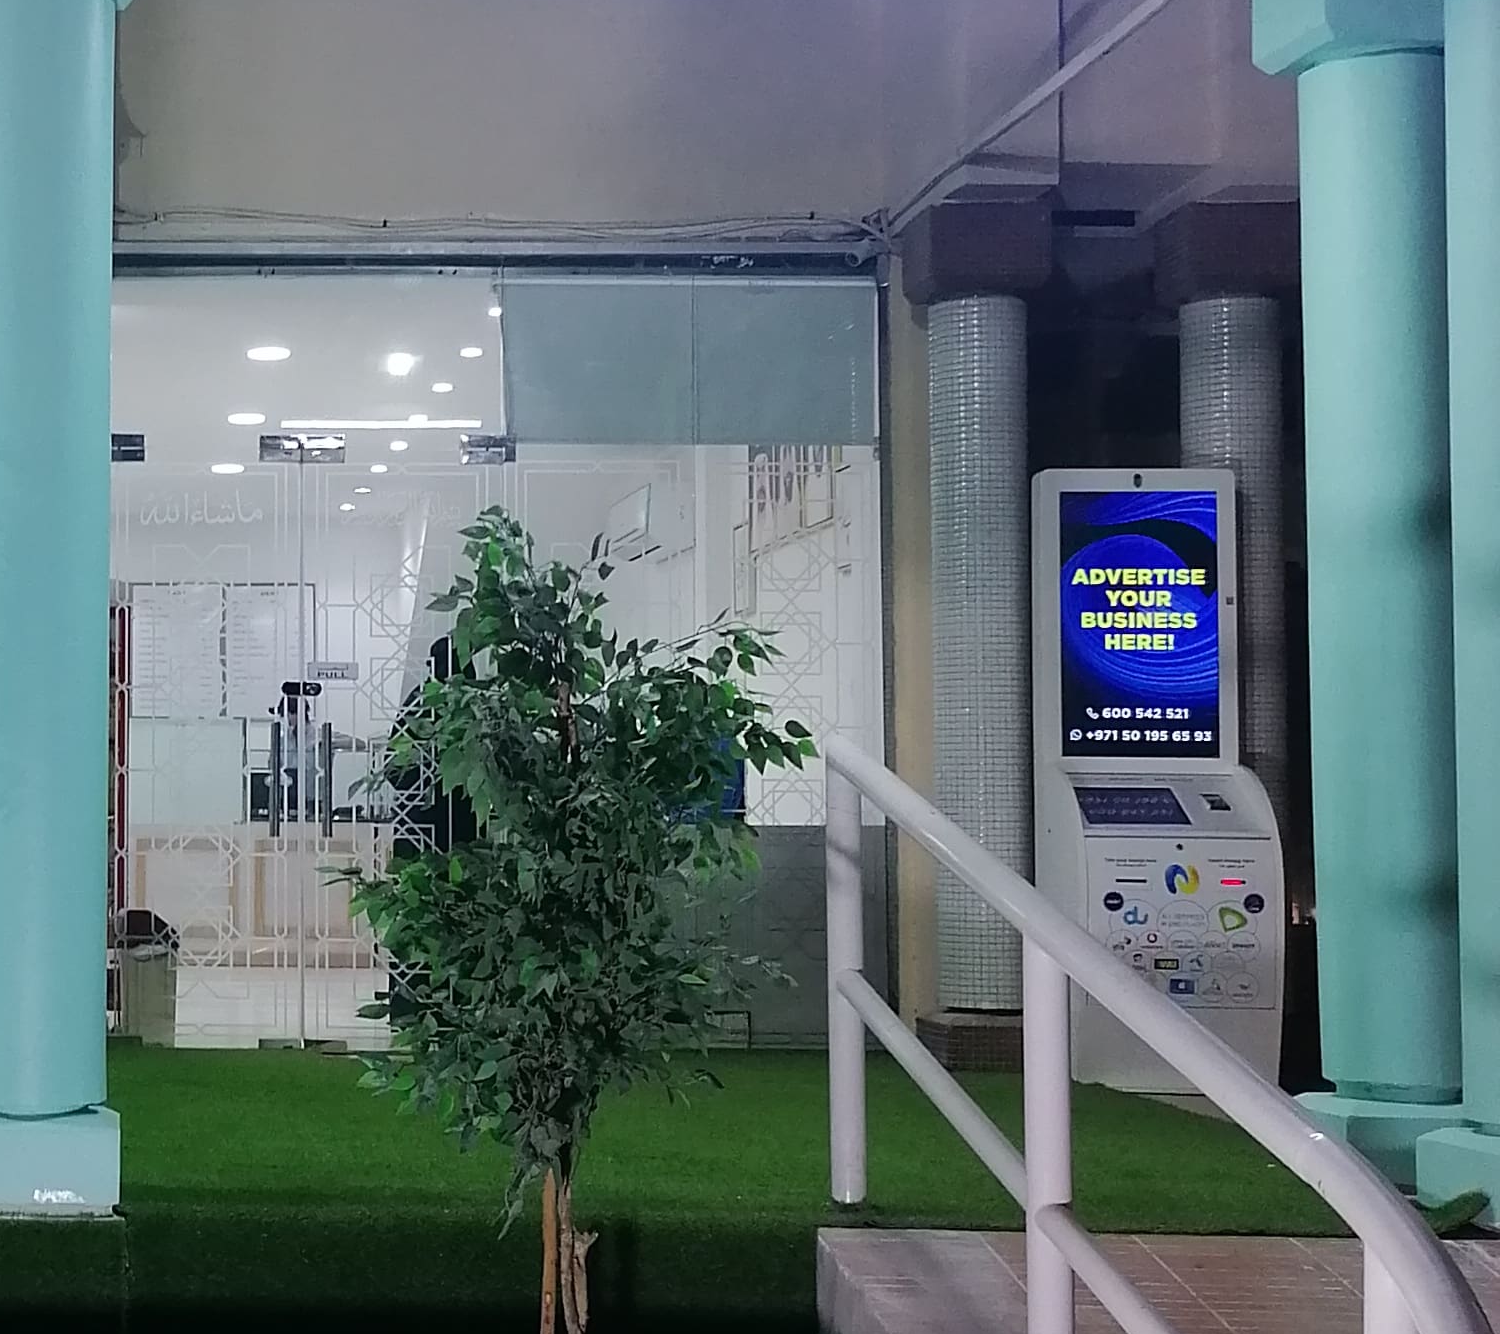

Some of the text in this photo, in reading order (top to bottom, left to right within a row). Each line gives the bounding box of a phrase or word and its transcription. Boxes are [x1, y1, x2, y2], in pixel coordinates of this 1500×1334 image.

[1071, 568, 1206, 585] ADVERTISE
[1105, 590, 1172, 607] YOUR
[1080, 612, 1198, 629] BUSINESS
[1104, 634, 1175, 651] HERE!
[316, 671, 349, 679] PULL
[1102, 707, 1189, 719] 600 542 521
[1086, 729, 1212, 742] +971 50 195 65 93
